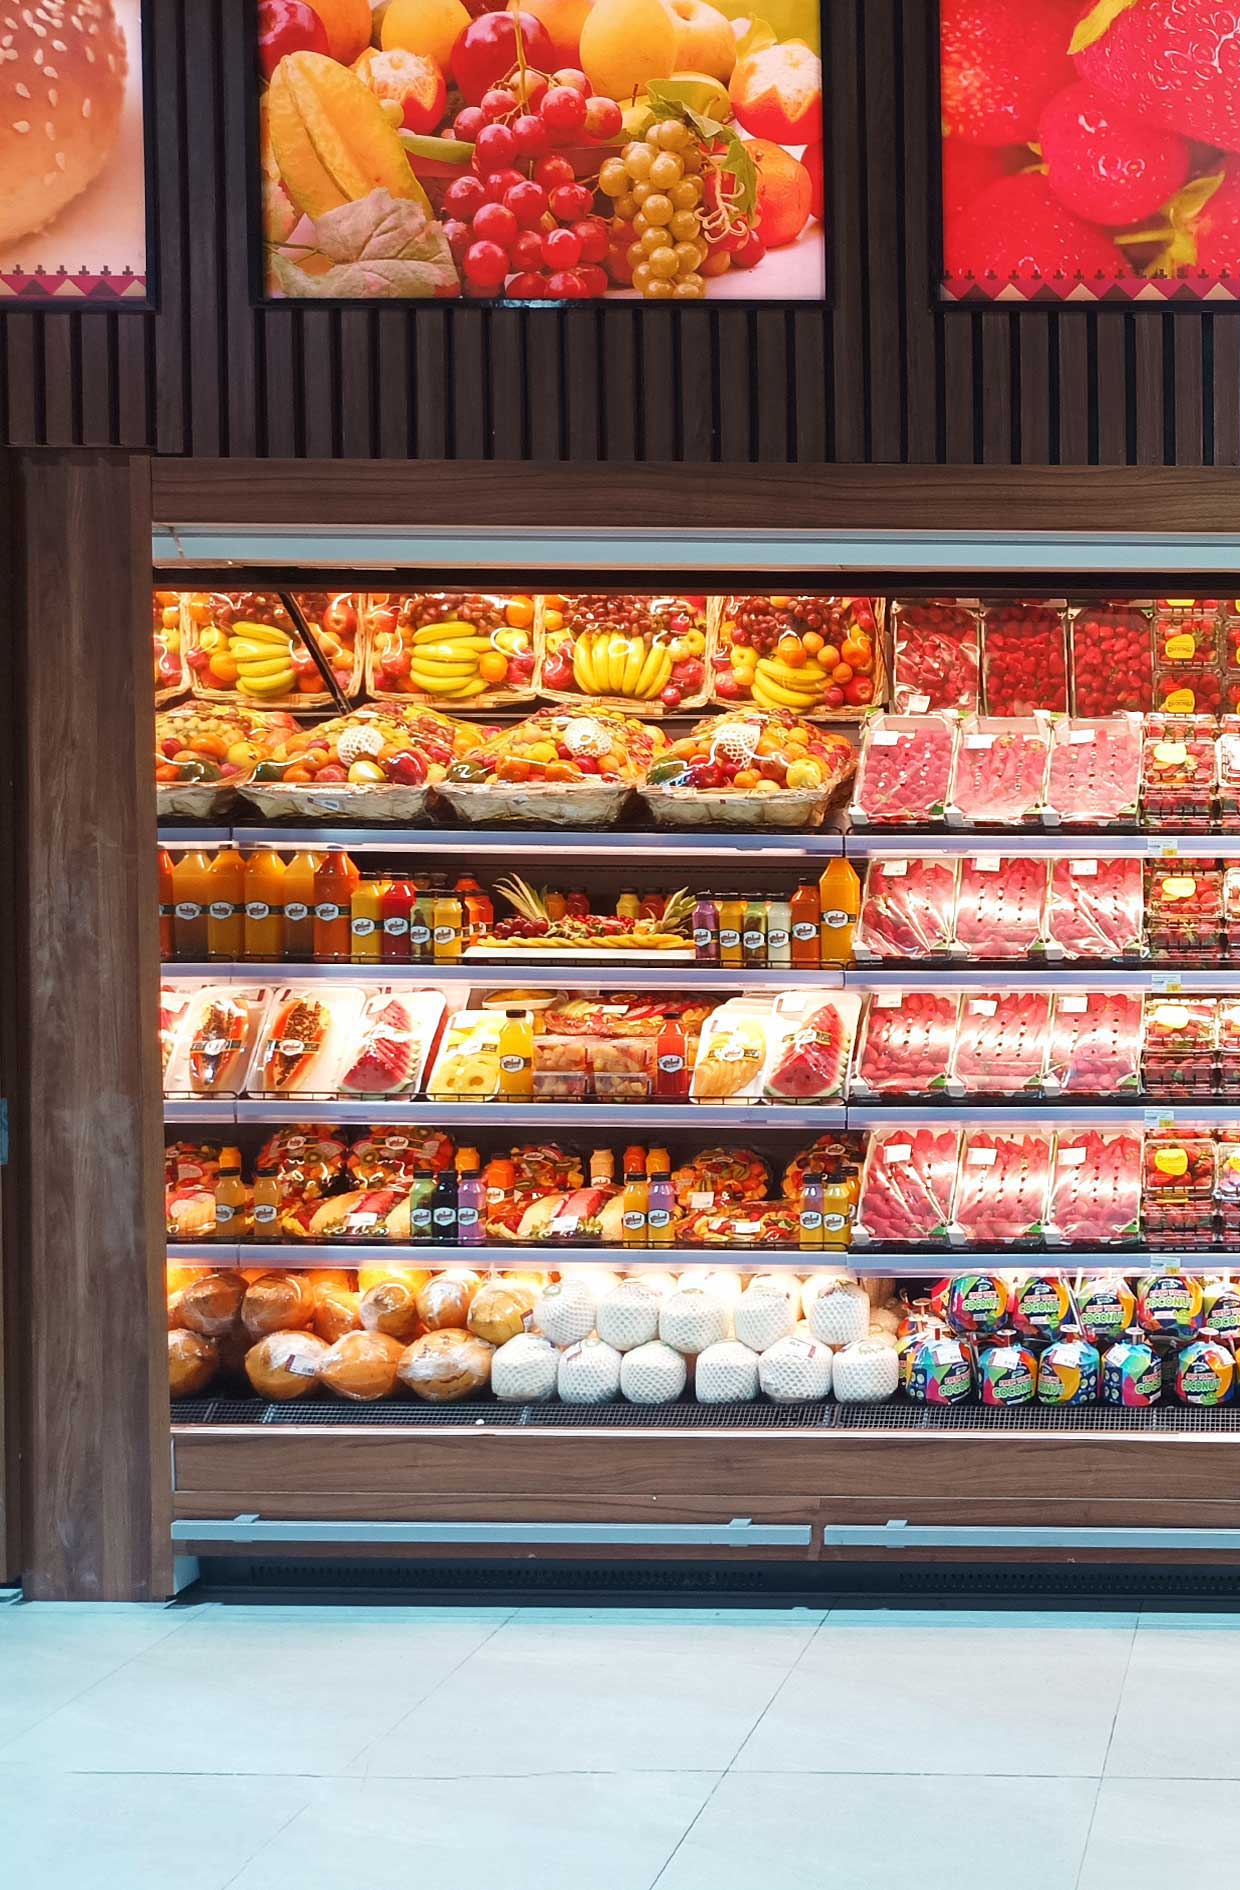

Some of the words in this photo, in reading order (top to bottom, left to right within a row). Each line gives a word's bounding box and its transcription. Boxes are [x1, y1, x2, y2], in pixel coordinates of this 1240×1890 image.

[1145, 1296, 1193, 1309] COCONUT
[1081, 1312, 1125, 1325] COCONUT
[1182, 1378, 1222, 1392] COCONUT
